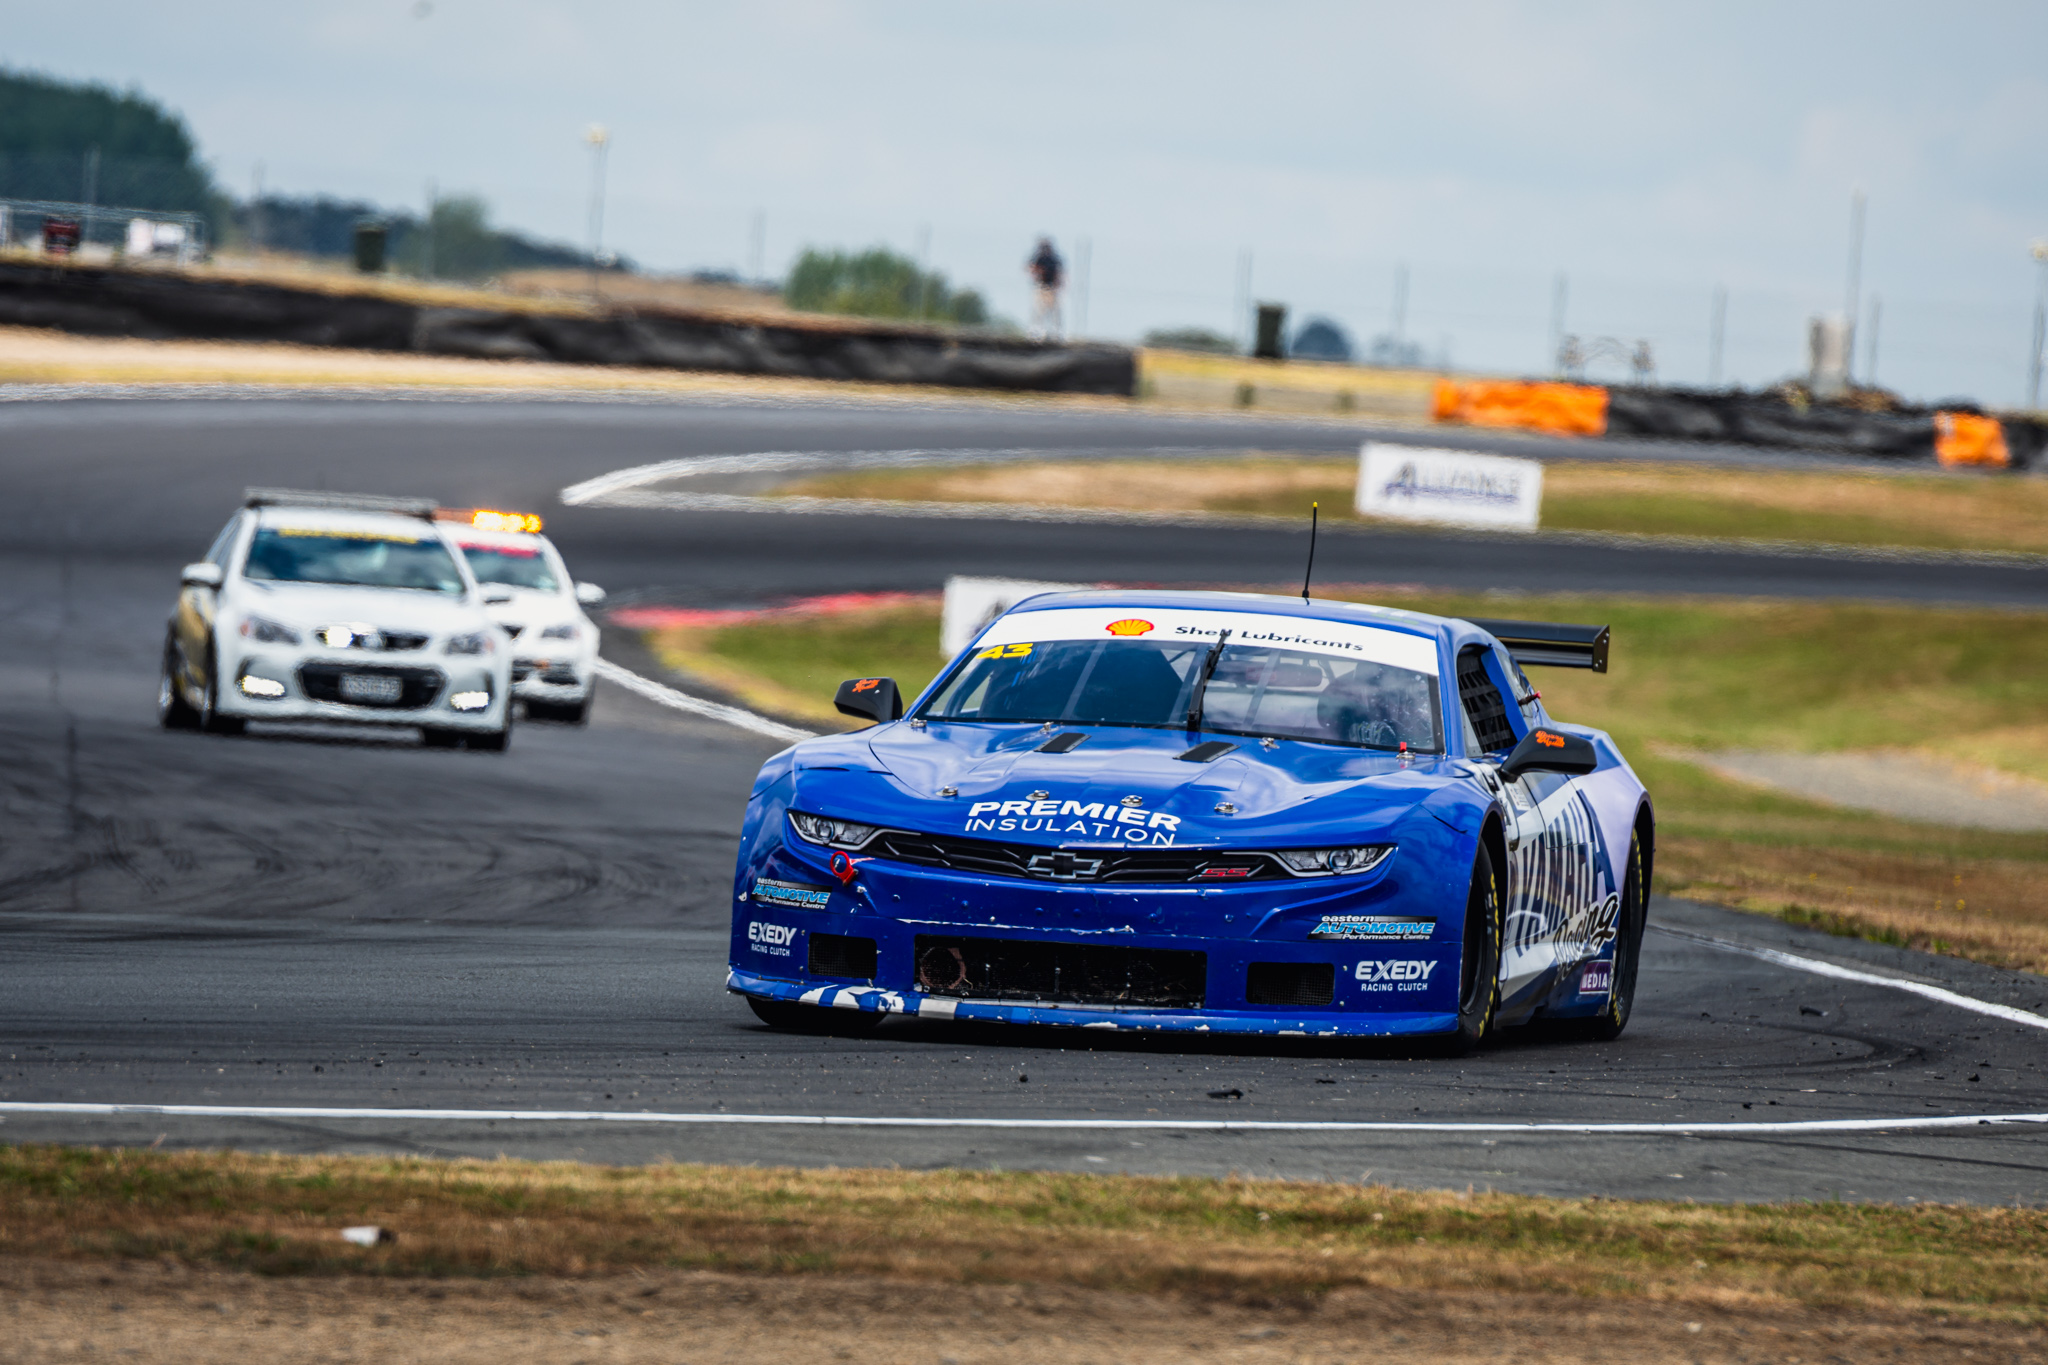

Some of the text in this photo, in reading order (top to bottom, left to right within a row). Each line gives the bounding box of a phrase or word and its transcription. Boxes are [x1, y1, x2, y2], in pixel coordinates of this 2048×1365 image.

[1240, 630, 1364, 651] Lubricants
[975, 643, 1034, 659] 43
[968, 800, 1182, 832] PREMIER
[964, 818, 1176, 848] INSULATION
[757, 877, 782, 886] eastern
[752, 884, 831, 904] AUTOMOTIVE
[765, 897, 800, 906] Performance
[748, 921, 797, 946] EXEDY
[1310, 922, 1436, 935] AUTOMOTIVE
[751, 943, 790, 956] RACING CLUTCH
[1354, 959, 1439, 982] EXEDY
[1360, 982, 1429, 992] RACING CLUTCH
